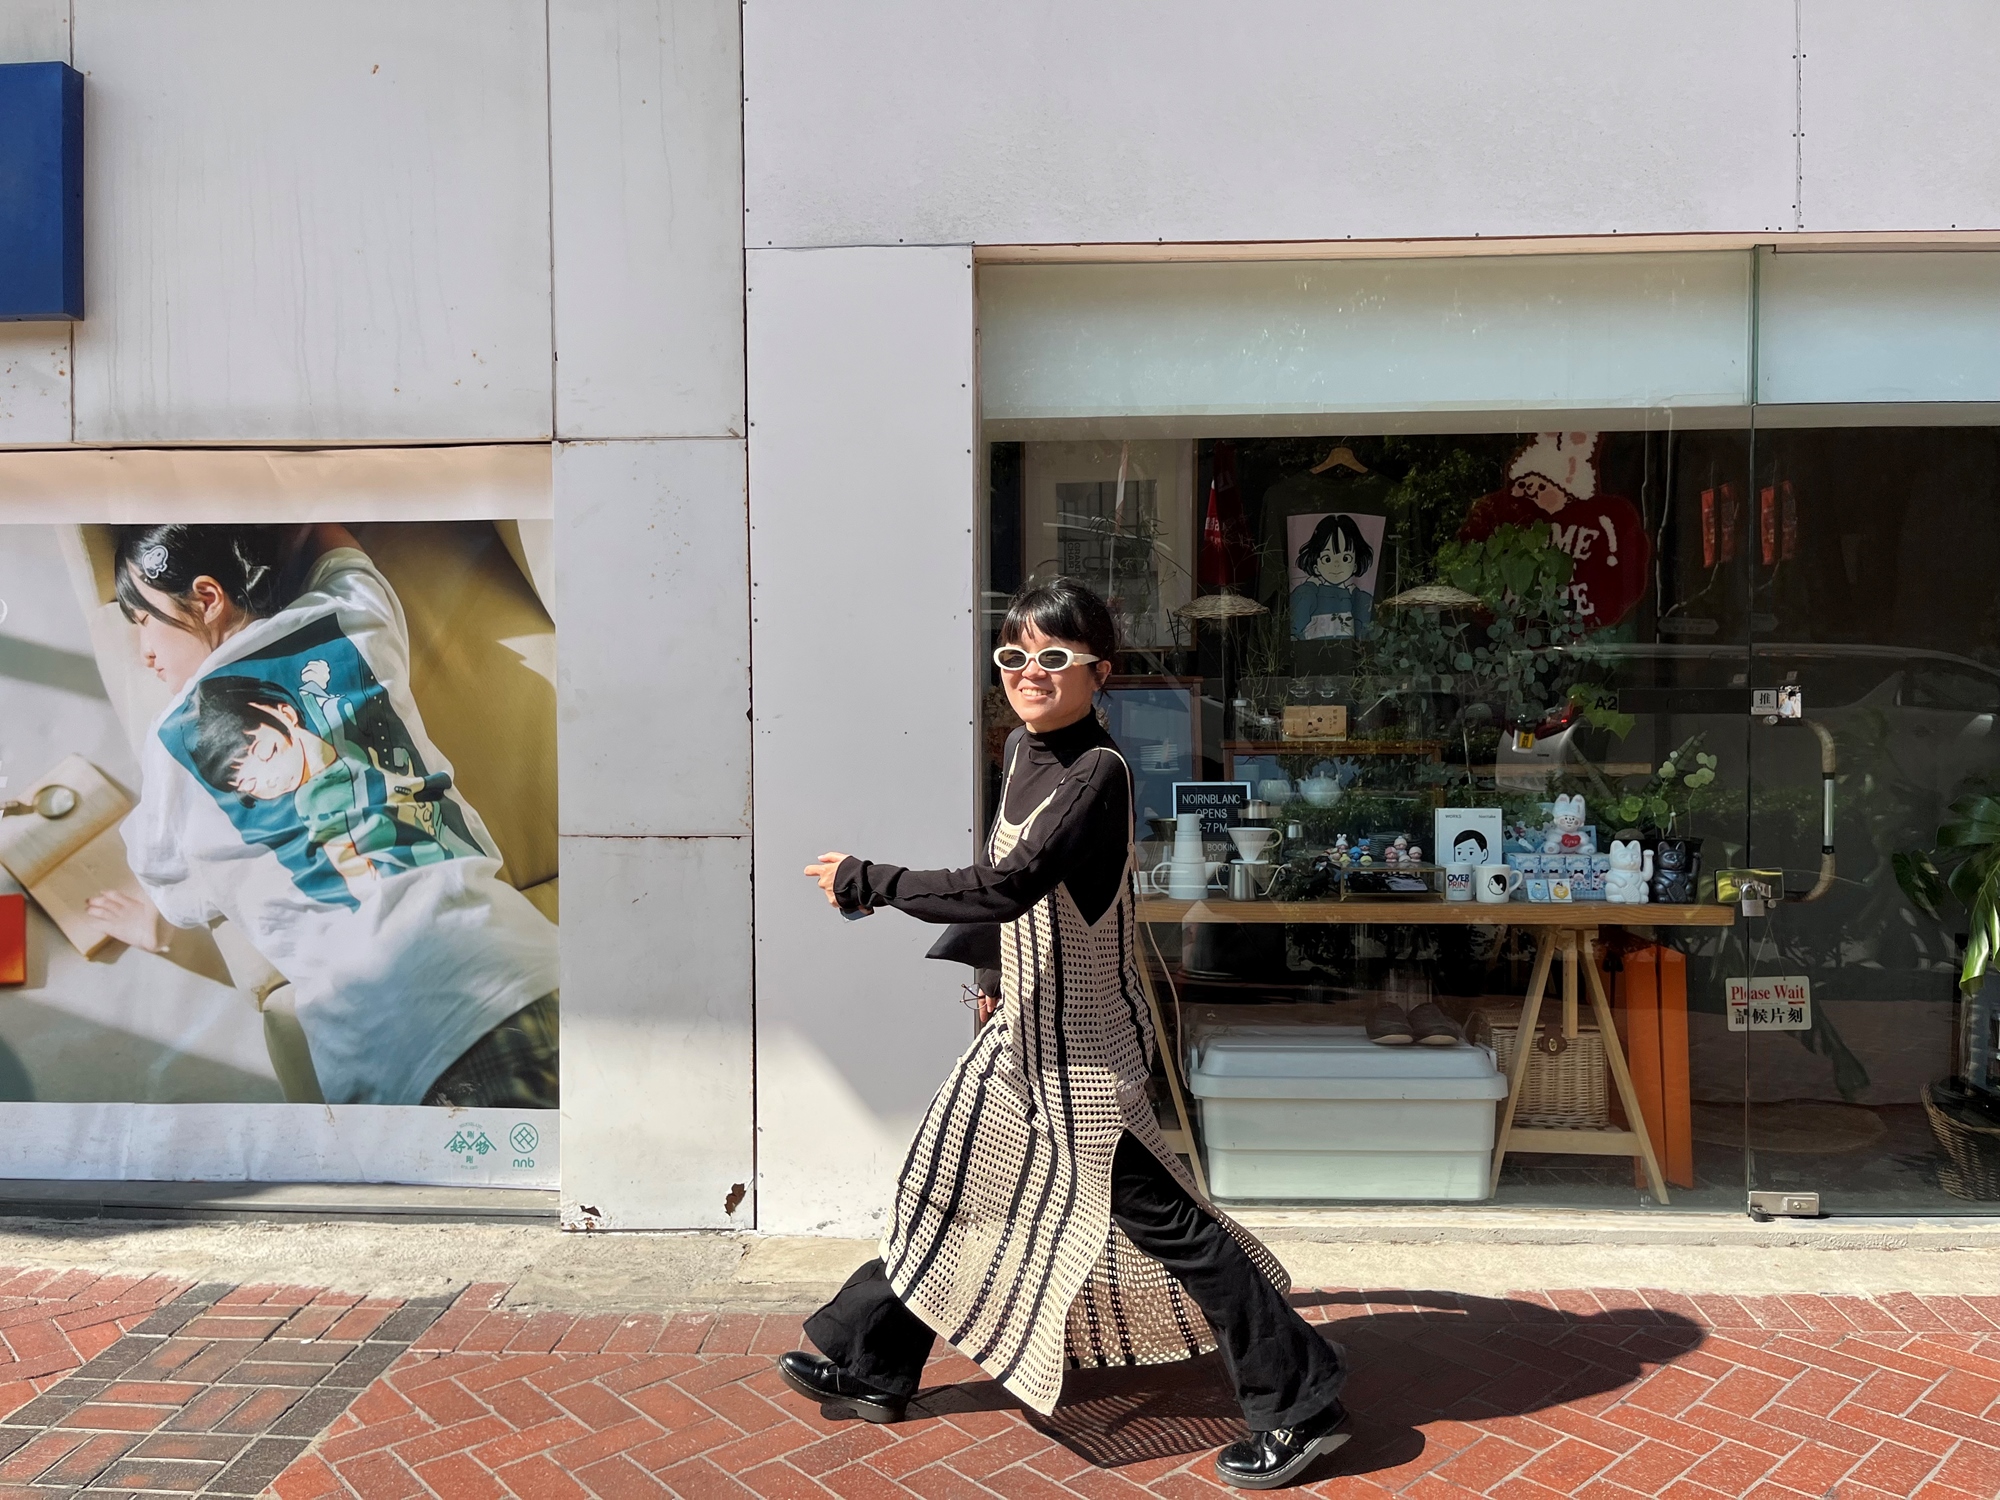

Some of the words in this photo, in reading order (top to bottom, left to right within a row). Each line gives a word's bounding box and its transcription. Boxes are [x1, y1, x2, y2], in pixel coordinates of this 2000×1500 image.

[1067, 542, 1075, 569] CHAIR
[1182, 793, 1241, 806] NOIRNBLANC
[1195, 808, 1228, 819] OPENS
[1213, 822, 1228, 833] PM
[1447, 873, 1470, 882] OVER
[1448, 881, 1469, 889] PRINT
[1774, 984, 1805, 999] Wait
[512, 1157, 535, 1168] nnb
